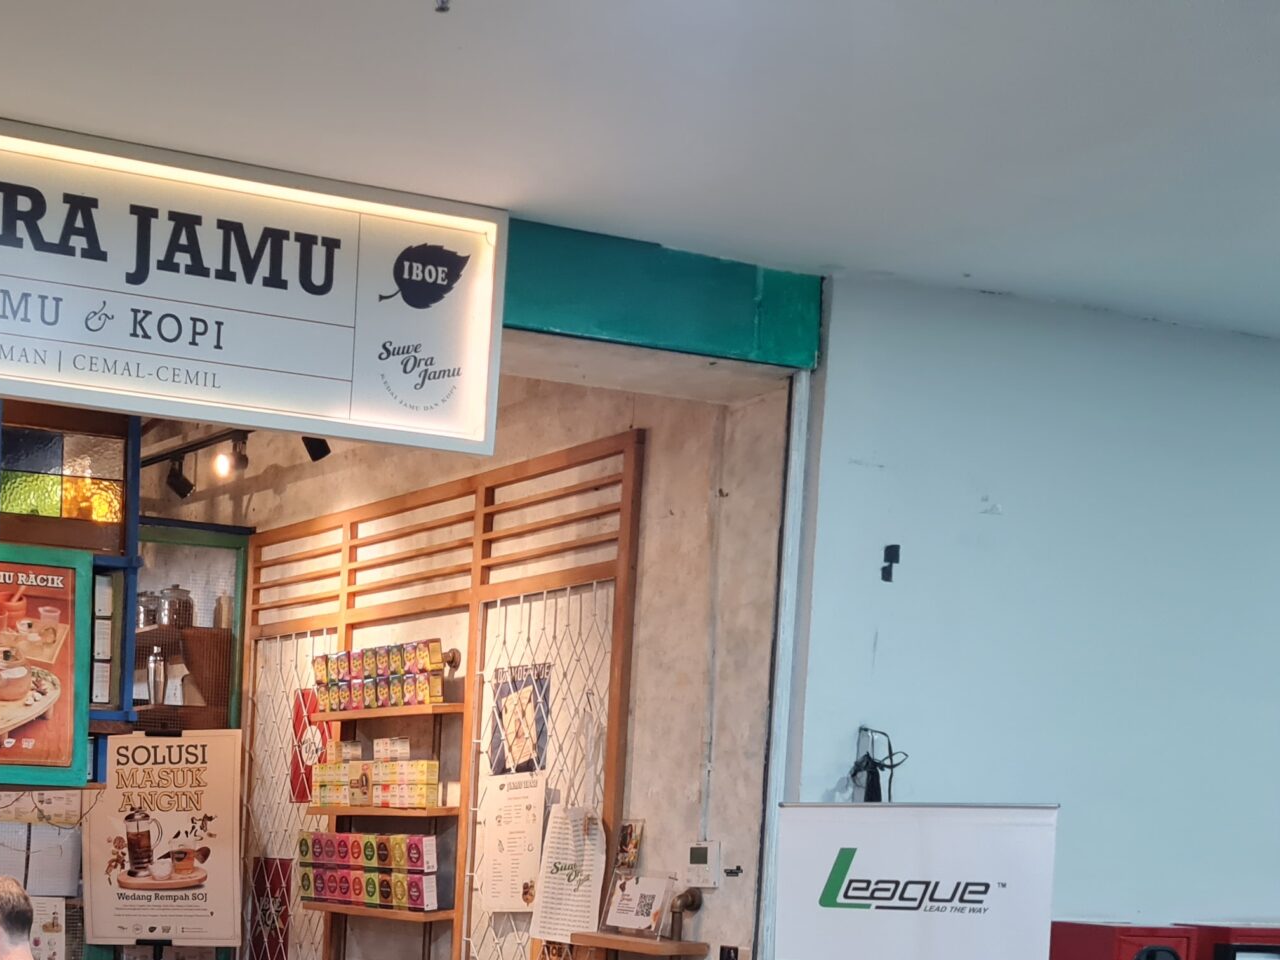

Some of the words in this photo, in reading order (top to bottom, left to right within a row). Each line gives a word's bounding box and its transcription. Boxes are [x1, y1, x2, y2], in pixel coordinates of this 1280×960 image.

[125, 203, 341, 297] JAMU
[402, 259, 449, 287] IBOE
[84, 300, 115, 333] &
[129, 307, 225, 351] KOPI
[377, 340, 423, 361] Suwe
[72, 353, 222, 389] CEMAL-CEMIL
[400, 354, 436, 375] Ora
[413, 367, 463, 391] Jamu
[116, 744, 208, 766] SOLUSI
[116, 766, 208, 790] MASUK
[118, 790, 205, 813] ANGIN
[818, 847, 991, 911] League
[116, 892, 153, 902] Wedang
[154, 892, 190, 903] Rempah
[191, 892, 208, 903] SOJ
[923, 904, 947, 913] LEAD
[949, 905, 967, 914] THE
[968, 905, 989, 915] WAY
